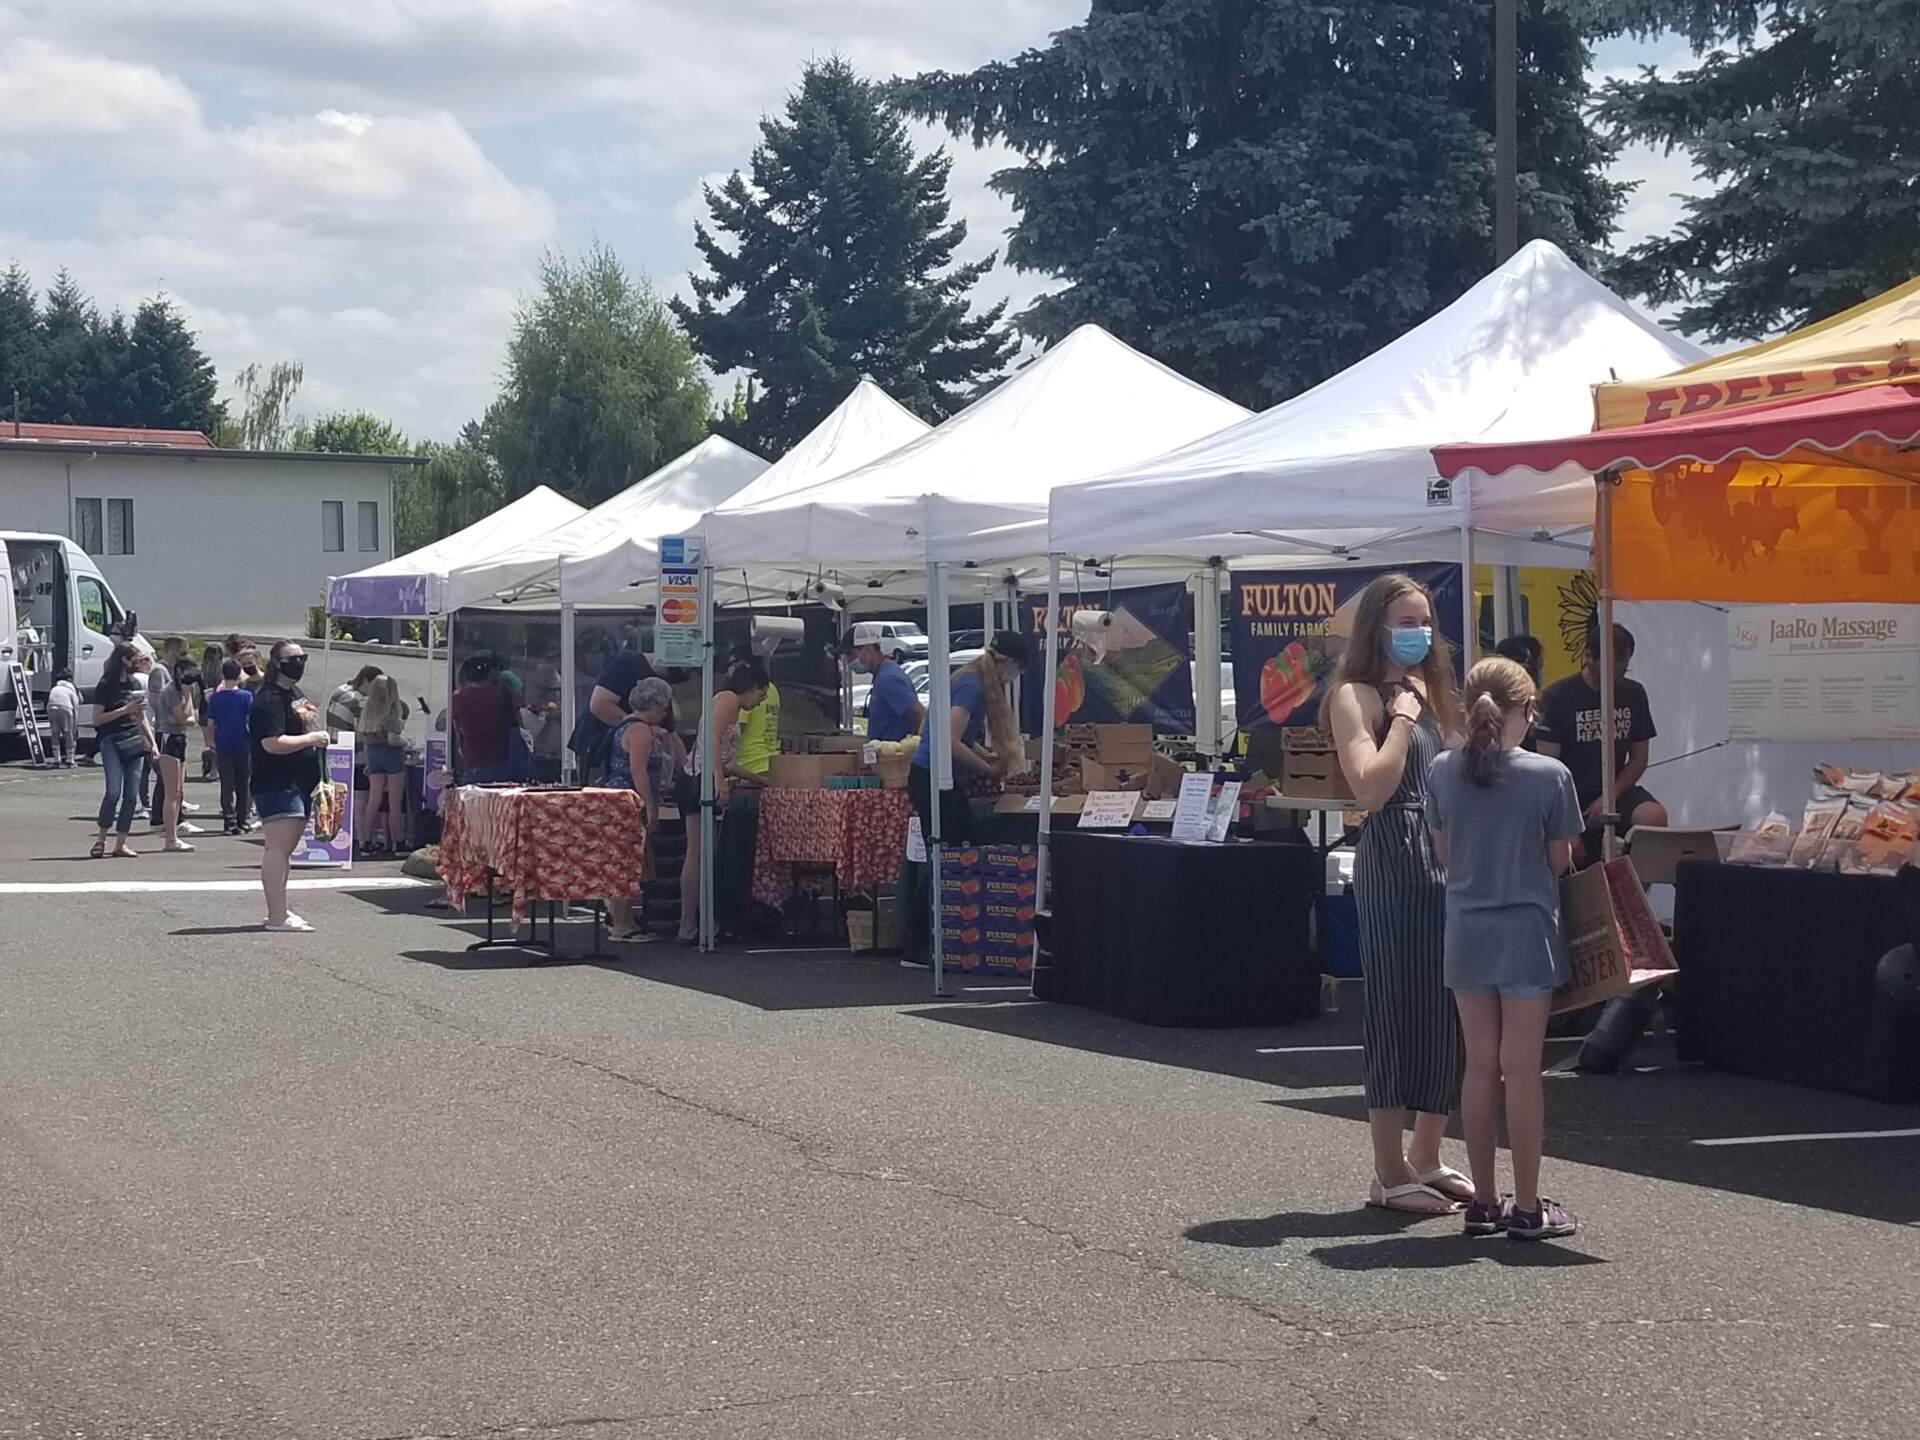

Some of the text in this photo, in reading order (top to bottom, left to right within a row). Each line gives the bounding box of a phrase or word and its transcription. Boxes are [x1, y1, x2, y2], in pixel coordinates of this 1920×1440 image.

[668, 575, 693, 586] VISA
[1240, 582, 1337, 617] FULTON
[1250, 621, 1330, 637] FAMILY FARMS
[1769, 616, 1898, 643] JaaRo Massage
[15, 672, 39, 755] WELCOME
[1575, 707, 1632, 723] KEENG
[1576, 719, 1631, 732] PORND
[1576, 729, 1630, 742] HEAHY
[987, 854, 1018, 863] FULTON
[986, 882, 1017, 890] FULTON
[986, 905, 1017, 913] FULTON
